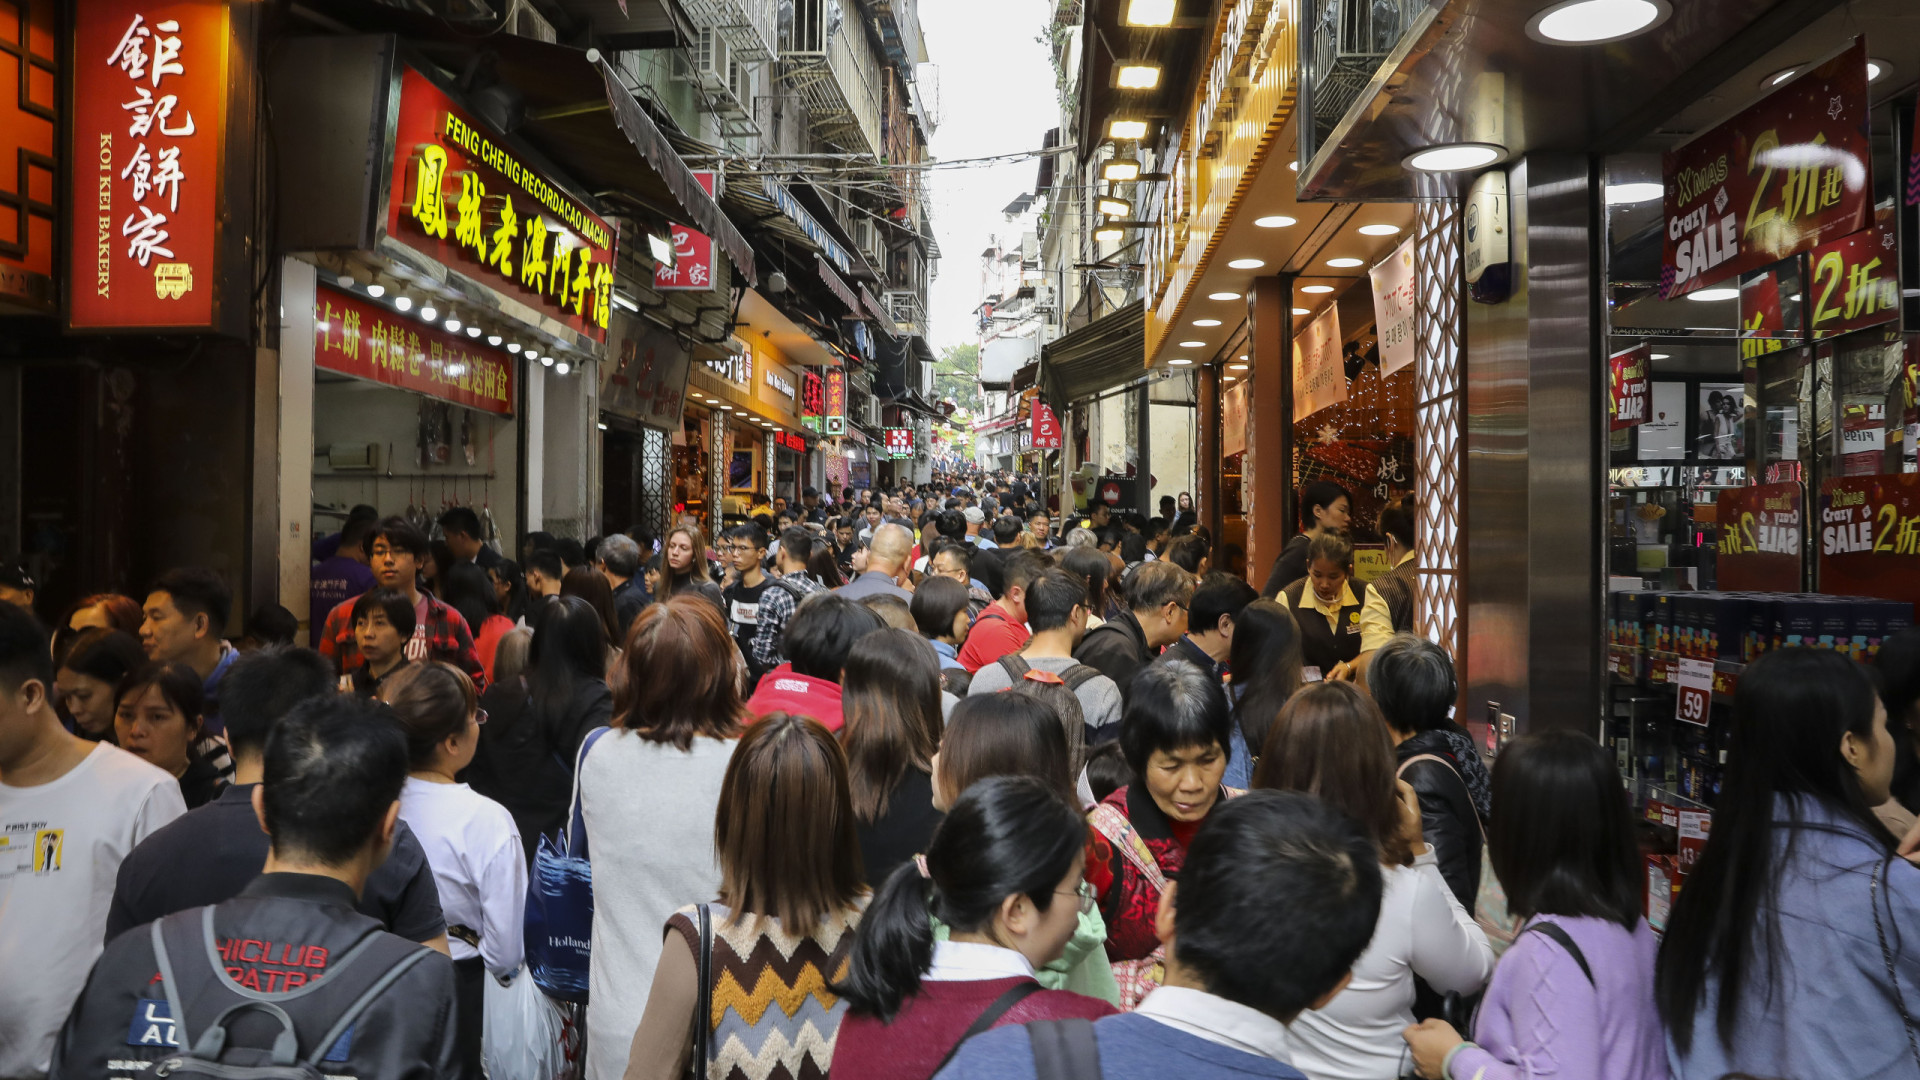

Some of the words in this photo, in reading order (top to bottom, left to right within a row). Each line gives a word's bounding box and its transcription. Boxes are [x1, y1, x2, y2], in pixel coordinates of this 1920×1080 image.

[100, 132, 112, 171] KOI
[99, 175, 111, 211] KEI
[446, 111, 480, 156] FENG
[482, 139, 520, 184] CHENG
[521, 168, 581, 231] RECORDACAO
[581, 215, 610, 251] MACAU
[412, 143, 614, 330] 鳳城老澳門手信
[1669, 203, 1708, 241] Crazy
[97, 215, 111, 299] BAKERY
[1675, 212, 1738, 285] SALE
[1823, 507, 1853, 524] Crazy
[1873, 503, 1920, 555] 2折
[1823, 521, 1873, 556] SALE
[1683, 691, 1703, 720] 59
[549, 936, 591, 950] Holland
